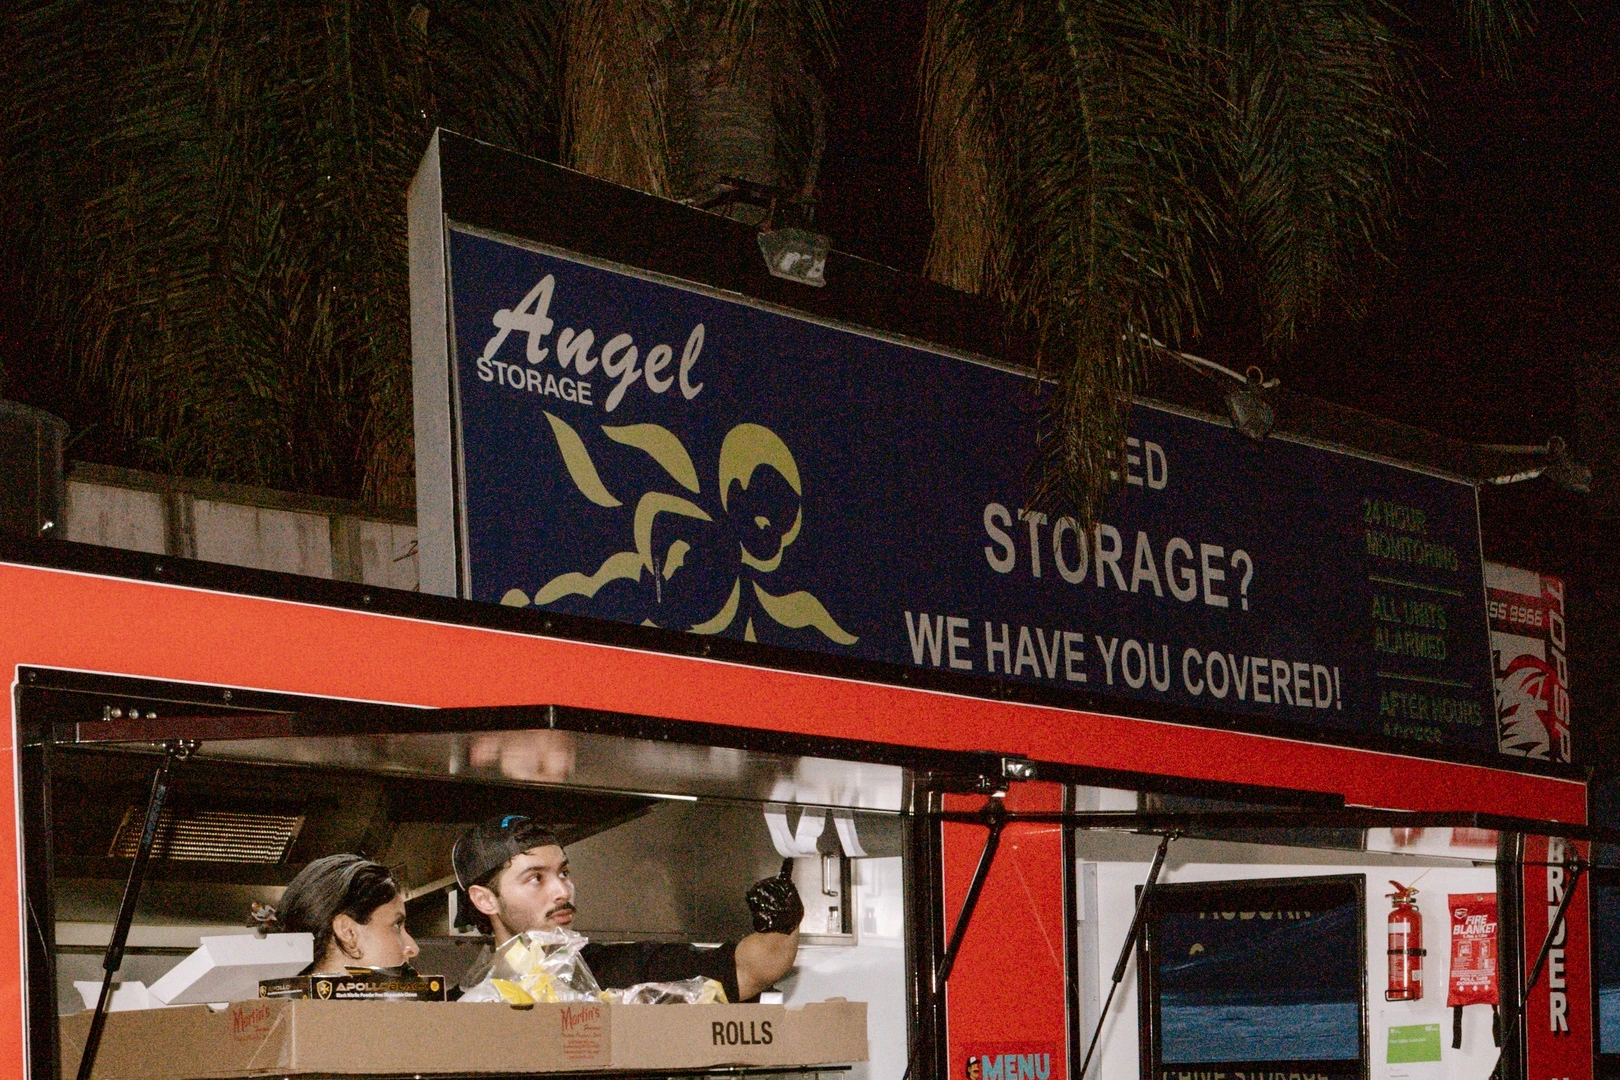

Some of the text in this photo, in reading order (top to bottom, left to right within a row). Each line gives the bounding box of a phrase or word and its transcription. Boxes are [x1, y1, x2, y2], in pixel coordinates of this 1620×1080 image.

[484, 274, 705, 412] Angel
[477, 357, 593, 405] STORAGE
[983, 502, 1254, 612] STORAGE?
[1372, 594, 1401, 623] ALL
[1488, 601, 1507, 620] 55
[1374, 626, 1447, 661] ALARMED
[905, 611, 1342, 710] WE HAVE YOU COVERED!
[1546, 577, 1571, 763] TOPSP
[1379, 690, 1429, 721] AFTER
[1453, 923, 1497, 935] BLANKET
[1465, 915, 1488, 925] FIRE
[560, 1006, 600, 1032] Martin's
[712, 1021, 774, 1046] ROLLS
